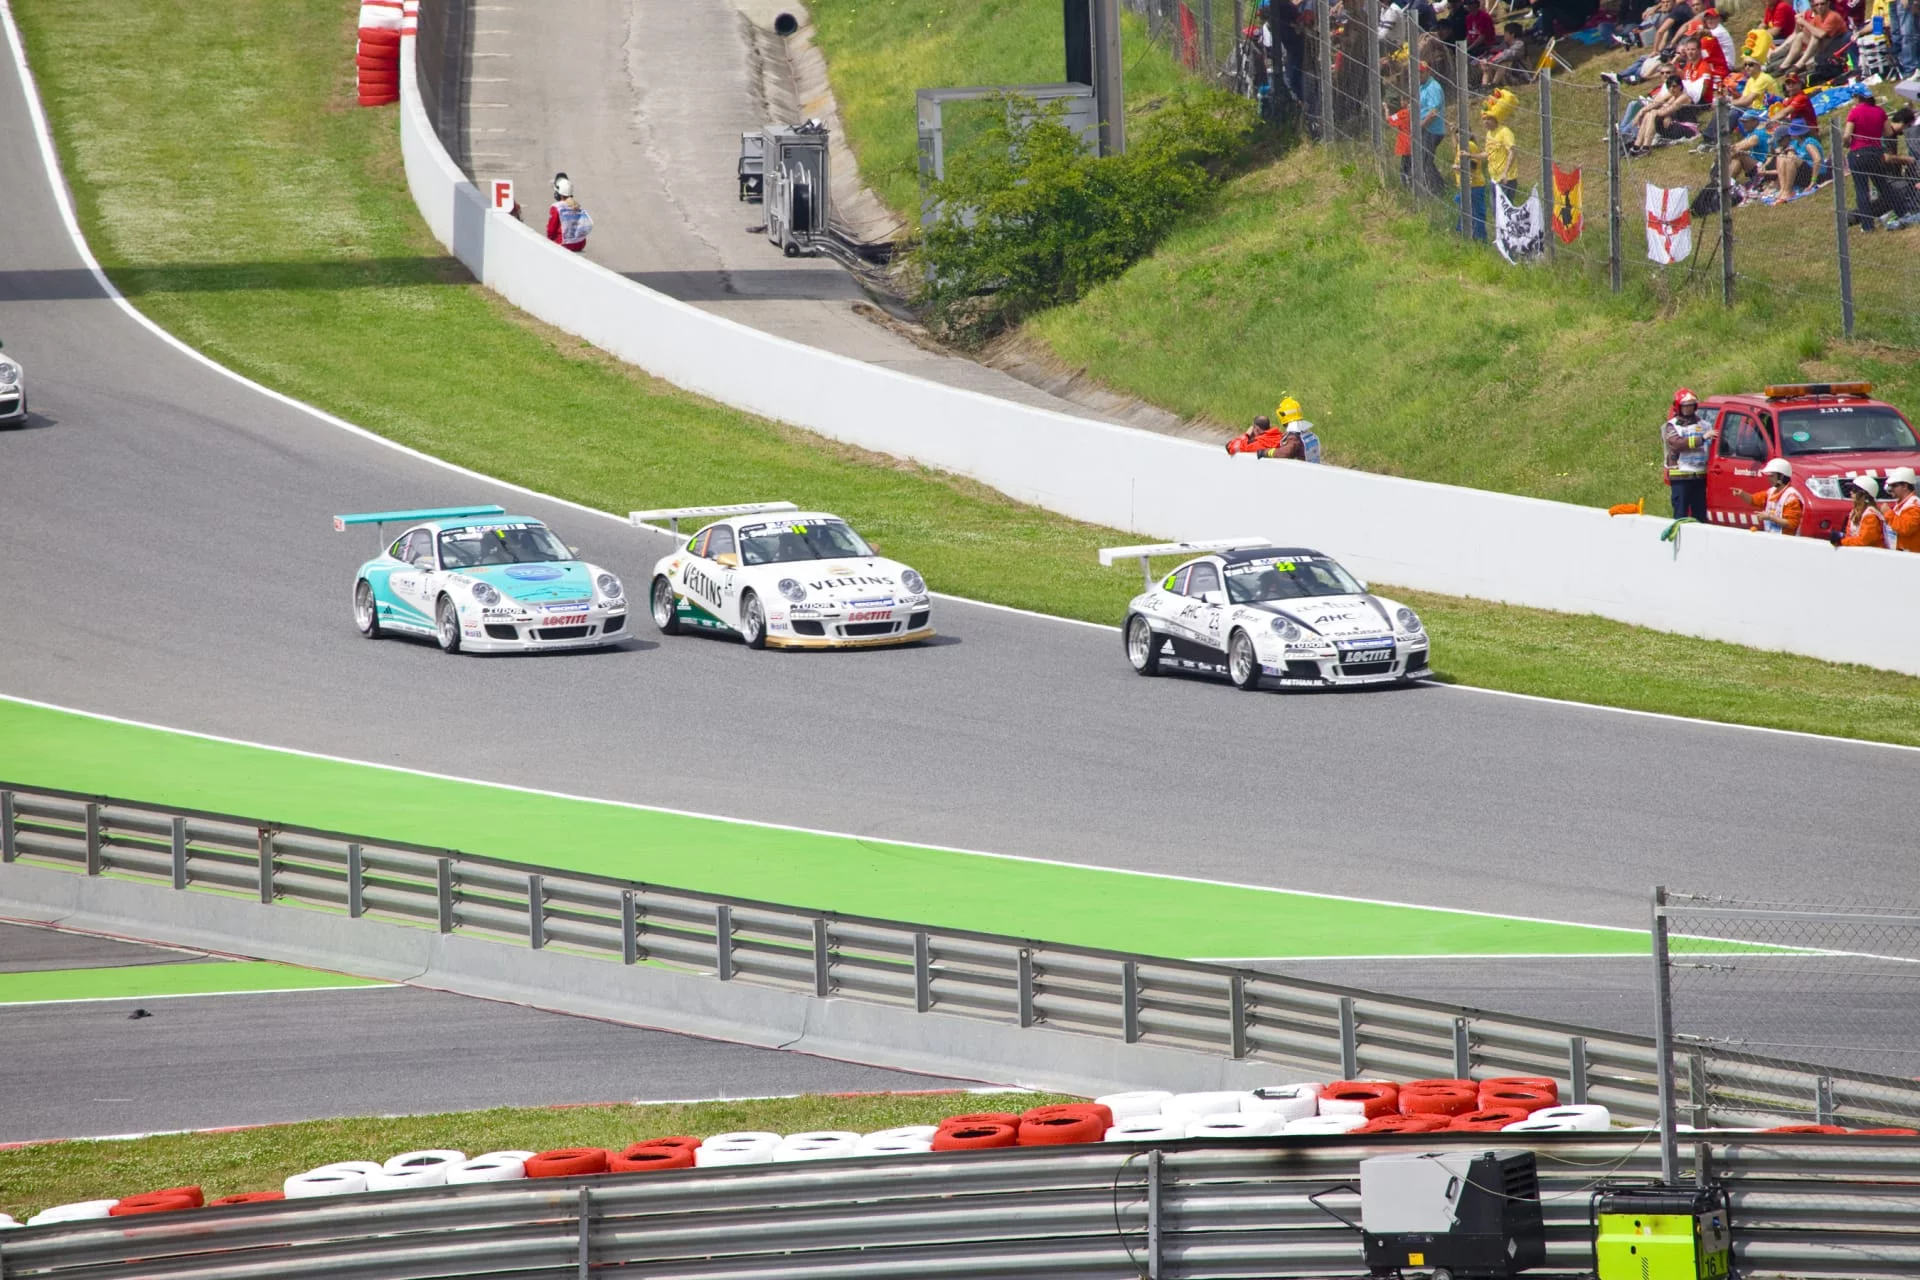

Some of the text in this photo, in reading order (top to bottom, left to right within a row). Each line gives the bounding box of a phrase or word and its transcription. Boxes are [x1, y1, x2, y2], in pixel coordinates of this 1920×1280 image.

[496, 183, 510, 208] F
[683, 562, 722, 609] VELTINS
[809, 576, 895, 591] VELTINS
[848, 610, 893, 622] LOCTITE
[1180, 604, 1202, 620] AHC
[1314, 613, 1356, 624] AHC
[542, 614, 588, 626] LOCTITE
[1208, 612, 1220, 630] 23
[1345, 649, 1392, 662] LOCTITE
[1705, 1256, 1717, 1276] 16
